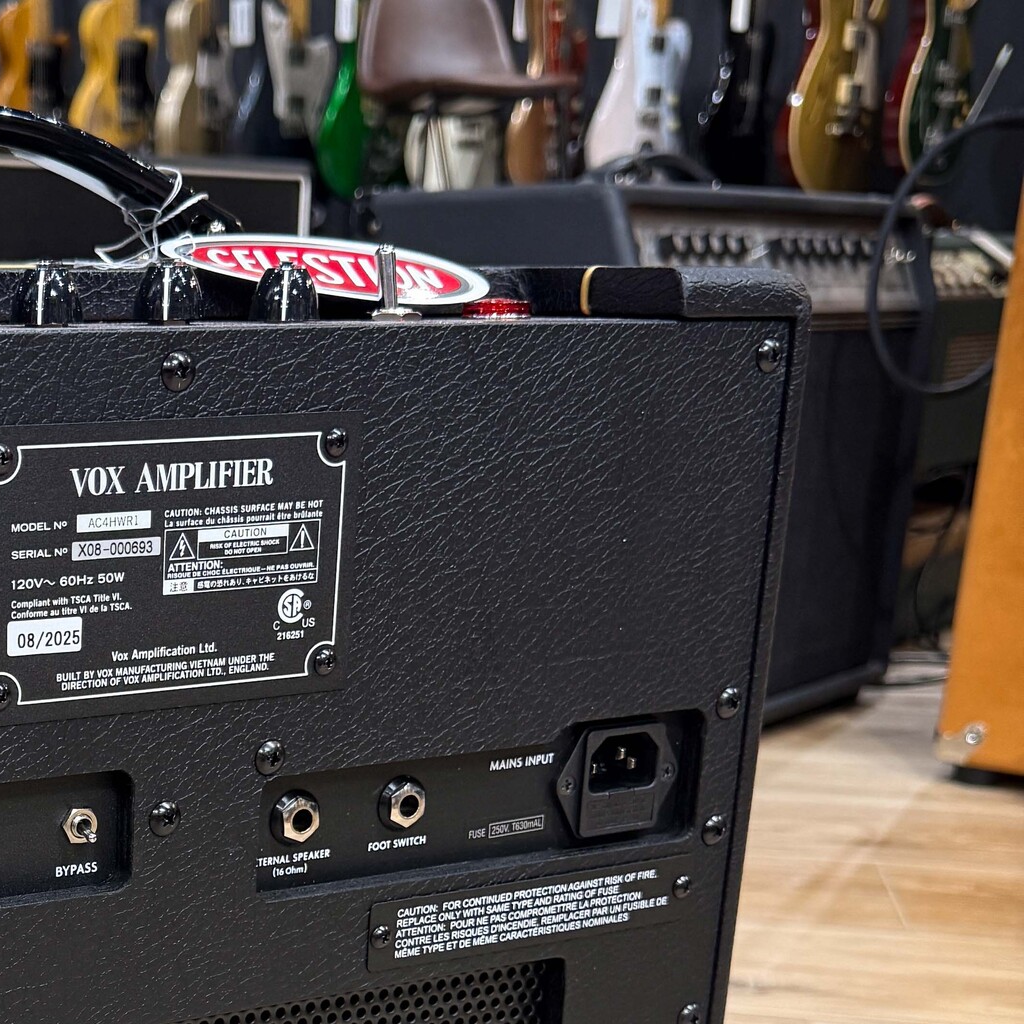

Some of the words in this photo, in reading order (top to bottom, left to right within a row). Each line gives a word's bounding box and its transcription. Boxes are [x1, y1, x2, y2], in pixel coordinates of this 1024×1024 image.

[70, 466, 125, 497] VOX
[134, 458, 273, 493] AMPLIFIER
[165, 508, 202, 518] CAUTION:
[205, 505, 238, 515] CHASSIS
[240, 503, 275, 513] SURFACE
[278, 502, 293, 510] MAY
[296, 501, 306, 509] BE
[308, 500, 323, 508] HOT
[11, 522, 51, 532] MODEL
[88, 515, 138, 528] AC4HWR1
[165, 520, 173, 528] La
[176, 518, 203, 526] surface
[206, 517, 215, 525] du
[217, 515, 244, 524] châssis
[246, 513, 275, 523] pourrait
[277, 511, 291, 520] être
[294, 510, 323, 519] brûlante
[224, 527, 267, 538] CAUTION
[78, 540, 153, 557] X08-000693
[233, 540, 259, 548] ELECTRIC
[11, 549, 51, 560] SERIAL
[168, 560, 223, 572] ATTENTION:
[60, 575, 94, 586] 60Hz
[98, 572, 125, 583] 50W
[11, 598, 50, 610] Compliant
[52, 597, 68, 606] with
[71, 595, 91, 604] TSCA
[93, 593, 110, 602] Title
[112, 593, 122, 601] VI.
[11, 608, 48, 619] Conforme
[62, 607, 77, 615] titre
[80, 606, 87, 614] VI
[90, 604, 99, 613] de
[101, 604, 107, 612] la
[110, 602, 132, 611] TSCA.
[302, 617, 315, 627] US
[18, 630, 80, 649] 08/2025
[277, 630, 304, 640] 216251
[111, 651, 129, 662] Vox
[131, 645, 196, 661] Amplification
[199, 642, 217, 653] Ltd.
[56, 671, 80, 682] BUILT
[83, 670, 95, 680] BY
[97, 669, 113, 678] VOX
[116, 662, 187, 676] MANUFACTURING
[189, 658, 226, 670] VIETNAM
[228, 655, 257, 665] UNDER
[259, 653, 275, 662] THE
[61, 678, 108, 691] DIRECTION
[110, 678, 122, 686] OF
[123, 676, 139, 685] VOX
[142, 668, 204, 683] AMPLIFICATION
[229, 663, 269, 675] ENGLAND.
[490, 757, 522, 771] MAINS
[525, 753, 554, 767] INPUT
[468, 828, 486, 839] FUSE
[512, 818, 541, 831] T630mAL
[368, 841, 391, 852] FOOT
[393, 835, 427, 849] SWITCH
[256, 855, 290, 867] TERNAL
[293, 849, 330, 862] SPEAKER
[55, 861, 98, 878] BYPASS
[272, 867, 284, 877] (16
[286, 863, 308, 875] Ohm)
[398, 904, 438, 918] CAUTION:
[442, 901, 461, 911] FOR
[462, 893, 512, 909] CONTINUED
[514, 884, 567, 899] PROTECTION
[568, 878, 603, 891] AGAINST
[604, 874, 623, 885] RISK
[625, 873, 637, 882] OF
[637, 869, 657, 880] FIRE.
[396, 914, 436, 928] REPLACE
[438, 910, 463, 922] ONLY
[463, 907, 485, 917] WITH
[486, 903, 510, 914] SAME
[512, 899, 533, 910] TYPE
[534, 898, 552, 907] AND
[553, 891, 583, 903] RATING
[585, 890, 596, 899] OF
[597, 885, 620, 896] FUSE
[396, 923, 446, 938] ATTENTION:
[450, 919, 475, 930] POUR
[476, 917, 489, 927] NE
[490, 913, 507, 924] PAS
[508, 901, 577, 921] COMPROMETTRE
[578, 900, 590, 909] LA
[590, 891, 641, 907] PROTECTION
[395, 934, 431, 949] CONTRE
[433, 932, 450, 942] LES
[451, 926, 490, 940] RISQUES
[541, 910, 591, 925] REMPLACER
[592, 906, 608, 917] PAR
[609, 904, 622, 914] UN
[623, 899, 655, 912] FUSIBLE
[656, 896, 668, 906] DE
[395, 947, 421, 959] MÊME
[423, 943, 444, 955] TYPE
[446, 940, 458, 951] ET
[459, 939, 472, 949] DE
[500, 921, 581, 941] CARACTÉRISTIQUES
[582, 912, 629, 929] NOMINALES
